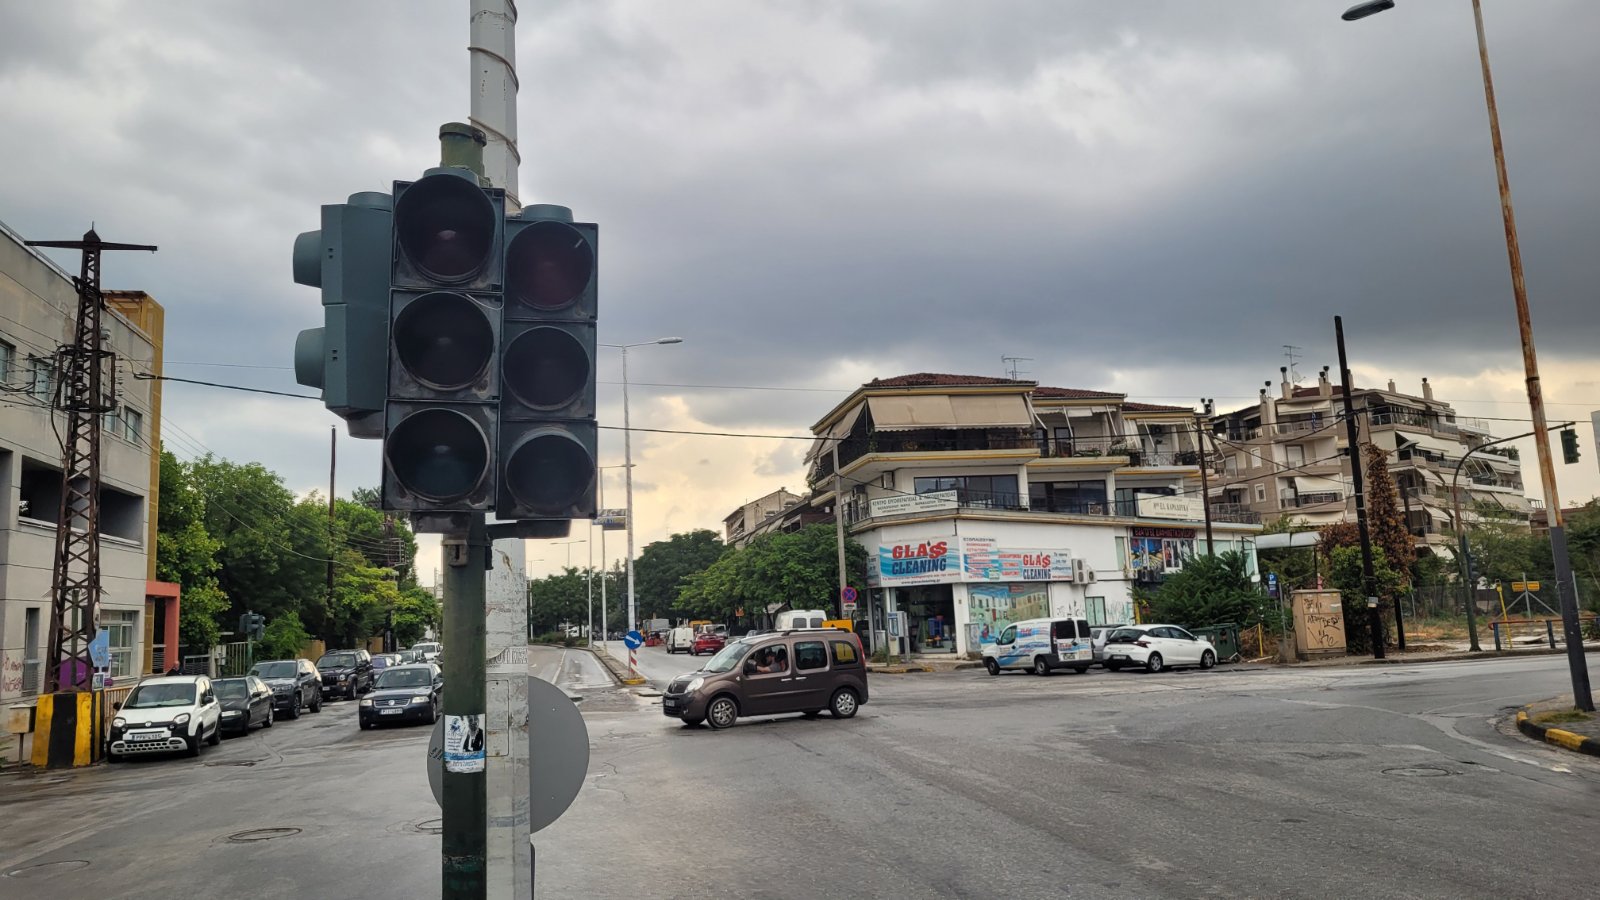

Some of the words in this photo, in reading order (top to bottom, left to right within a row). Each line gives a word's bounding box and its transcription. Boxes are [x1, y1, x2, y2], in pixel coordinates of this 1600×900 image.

[892, 541, 948, 559] GLASS
[892, 559, 947, 575] CLEANING
[1023, 554, 1051, 568] GLASS
[1023, 569, 1051, 580] CLEANING
